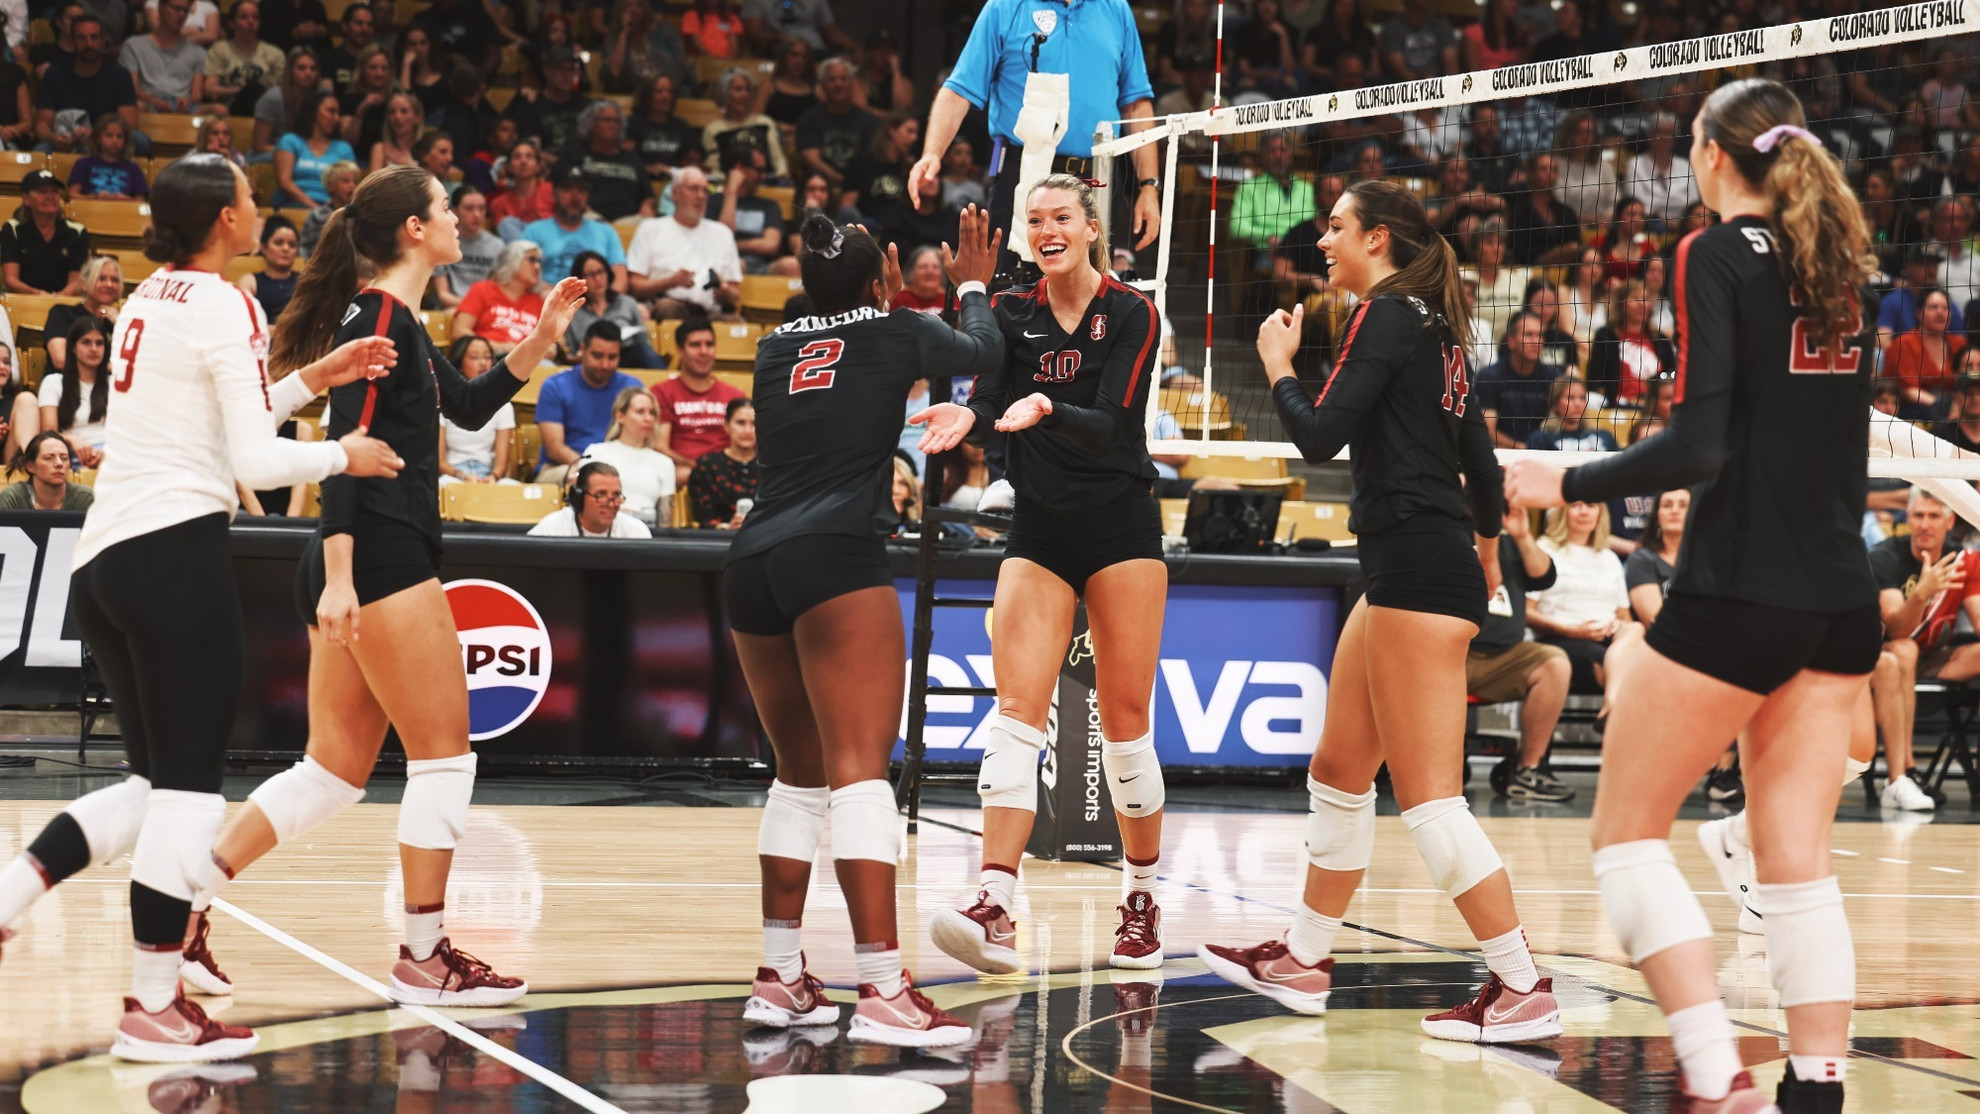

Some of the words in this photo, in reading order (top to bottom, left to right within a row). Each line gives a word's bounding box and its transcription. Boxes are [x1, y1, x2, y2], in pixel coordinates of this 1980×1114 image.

[1828, 10, 1890, 42] COLORADO
[1893, 0, 1965, 34] VOLLEYBALL
[1649, 40, 1700, 69] COLORADO
[1703, 29, 1765, 62] VOLLEYBALL
[1354, 85, 1396, 110] COLORADO
[1396, 78, 1445, 105] VOLLEYBALL
[1492, 64, 1537, 91] COLORADO
[1539, 56, 1594, 84] VOLLEYBALL
[114, 318, 145, 394] 9
[788, 337, 845, 395] 2
[1033, 349, 1082, 383] 10
[1440, 340, 1470, 418] 14
[460, 643, 541, 677] PSI
[1085, 688, 1101, 747] sports
[1083, 750, 1101, 822] imports
